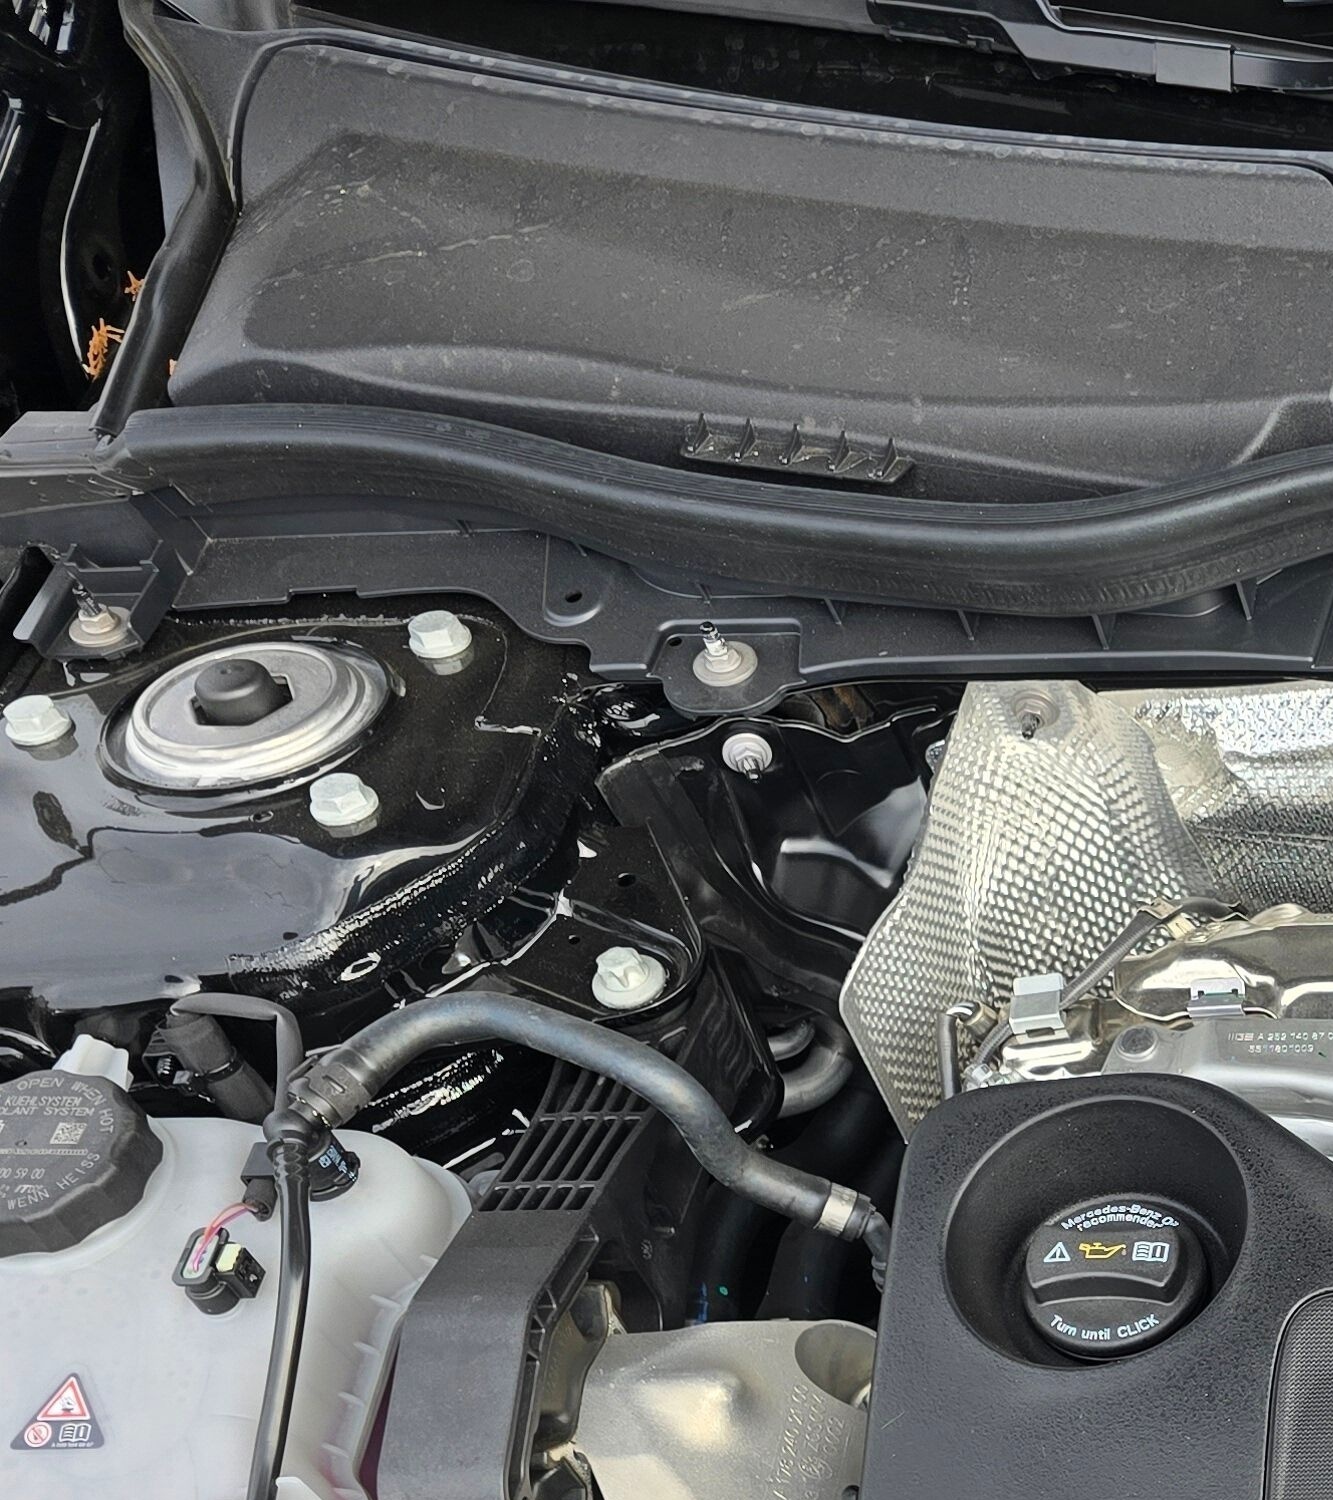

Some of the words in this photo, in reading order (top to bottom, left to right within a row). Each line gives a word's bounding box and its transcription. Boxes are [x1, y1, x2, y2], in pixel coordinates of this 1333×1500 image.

[5, 1096, 82, 1107] KUEHLSYSTEM
[17, 1077, 65, 1090] OPEN
[71, 1081, 104, 1106] WHEN
[99, 1108, 114, 1134] HOT
[44, 1107, 95, 1116] SYSTEM
[7, 1189, 50, 1210] WENN
[56, 1152, 100, 1190] HEISS
[14, 1168, 28, 1179] 59
[31, 1168, 45, 1179] 00
[1060, 1204, 1162, 1230] Mercedes-Benz
[1050, 1314, 1077, 1336] Turn
[1081, 1328, 1110, 1340] until
[1116, 1313, 1160, 1338] CLICK
